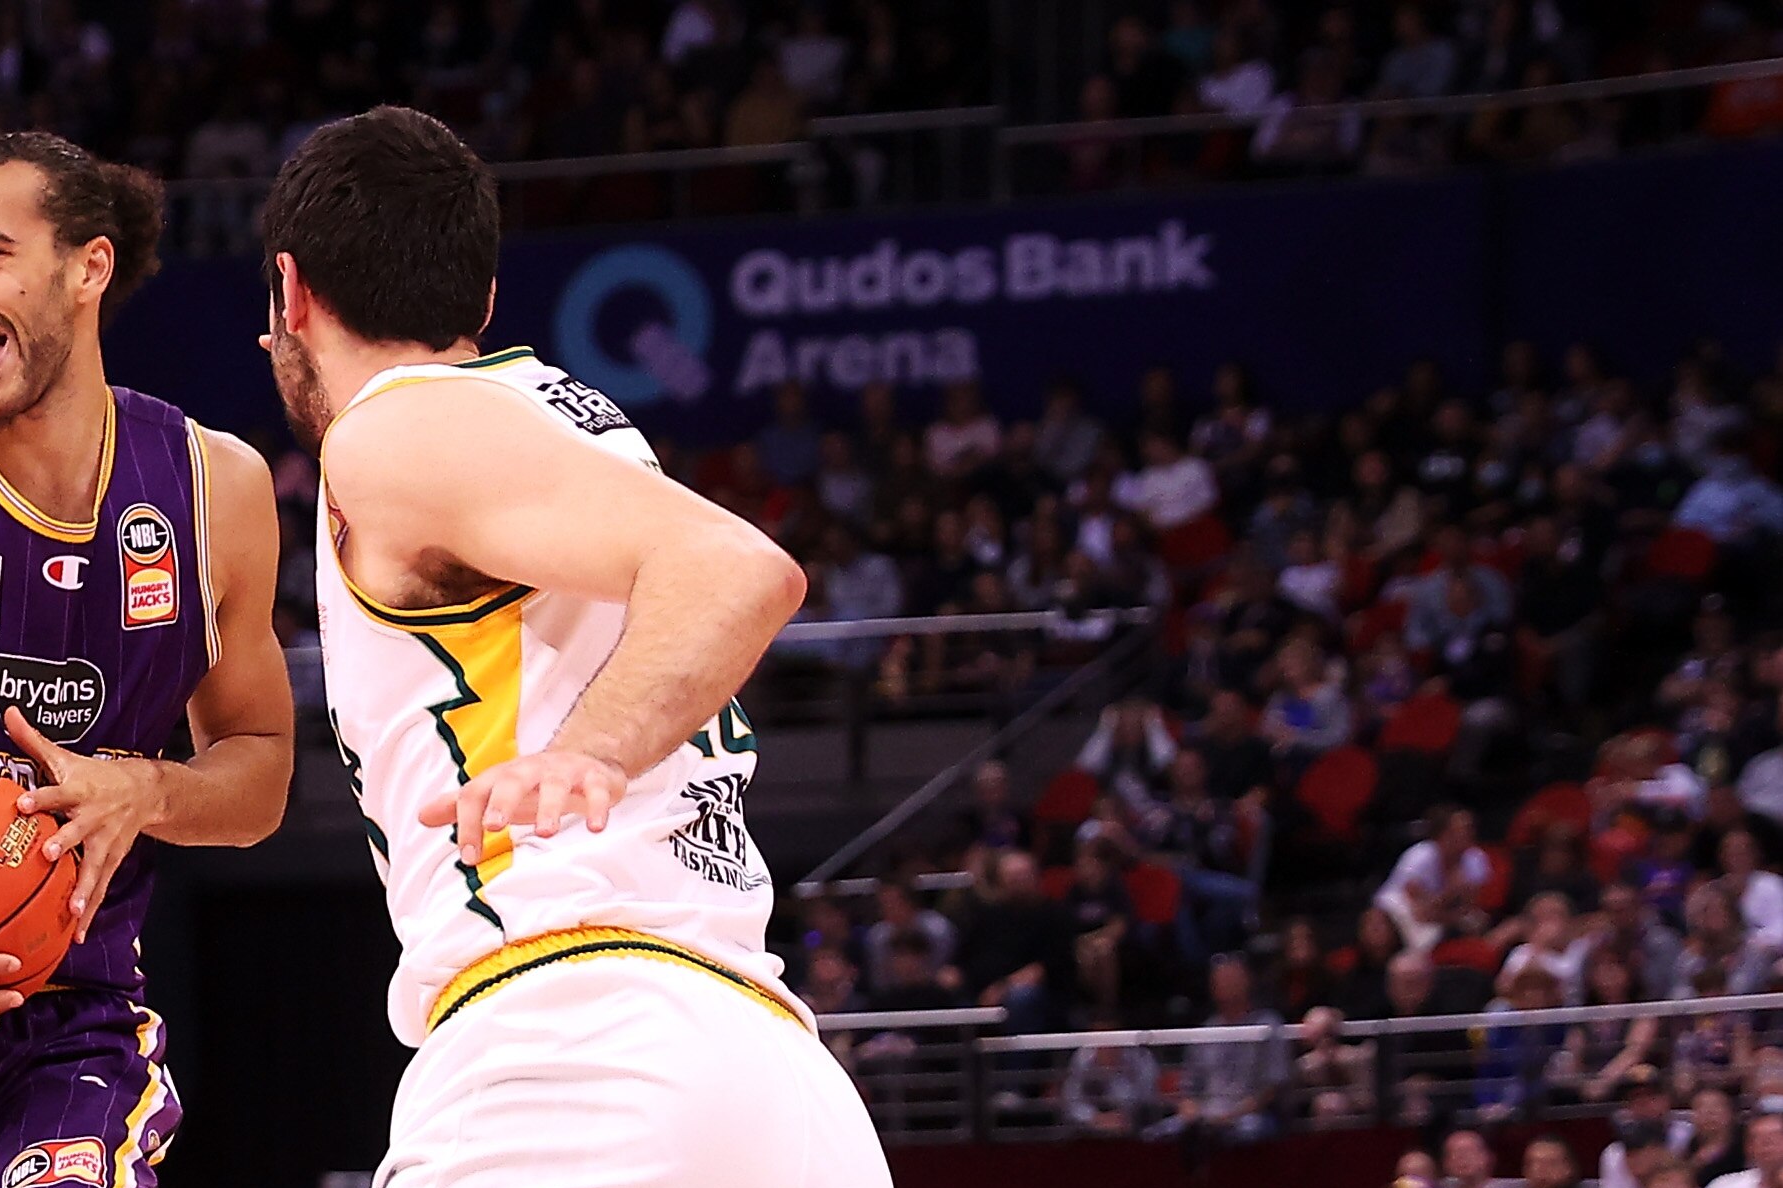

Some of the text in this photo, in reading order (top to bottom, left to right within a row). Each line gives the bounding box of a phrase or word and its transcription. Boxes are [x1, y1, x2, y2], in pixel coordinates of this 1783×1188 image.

[731, 221, 1213, 315] Qudos Bank
[739, 328, 979, 390] Arena
[129, 523, 161, 549] NBL
[130, 582, 169, 595] HUNGRY
[131, 591, 171, 609] JACK'S
[11, 1157, 38, 1187] NBL
